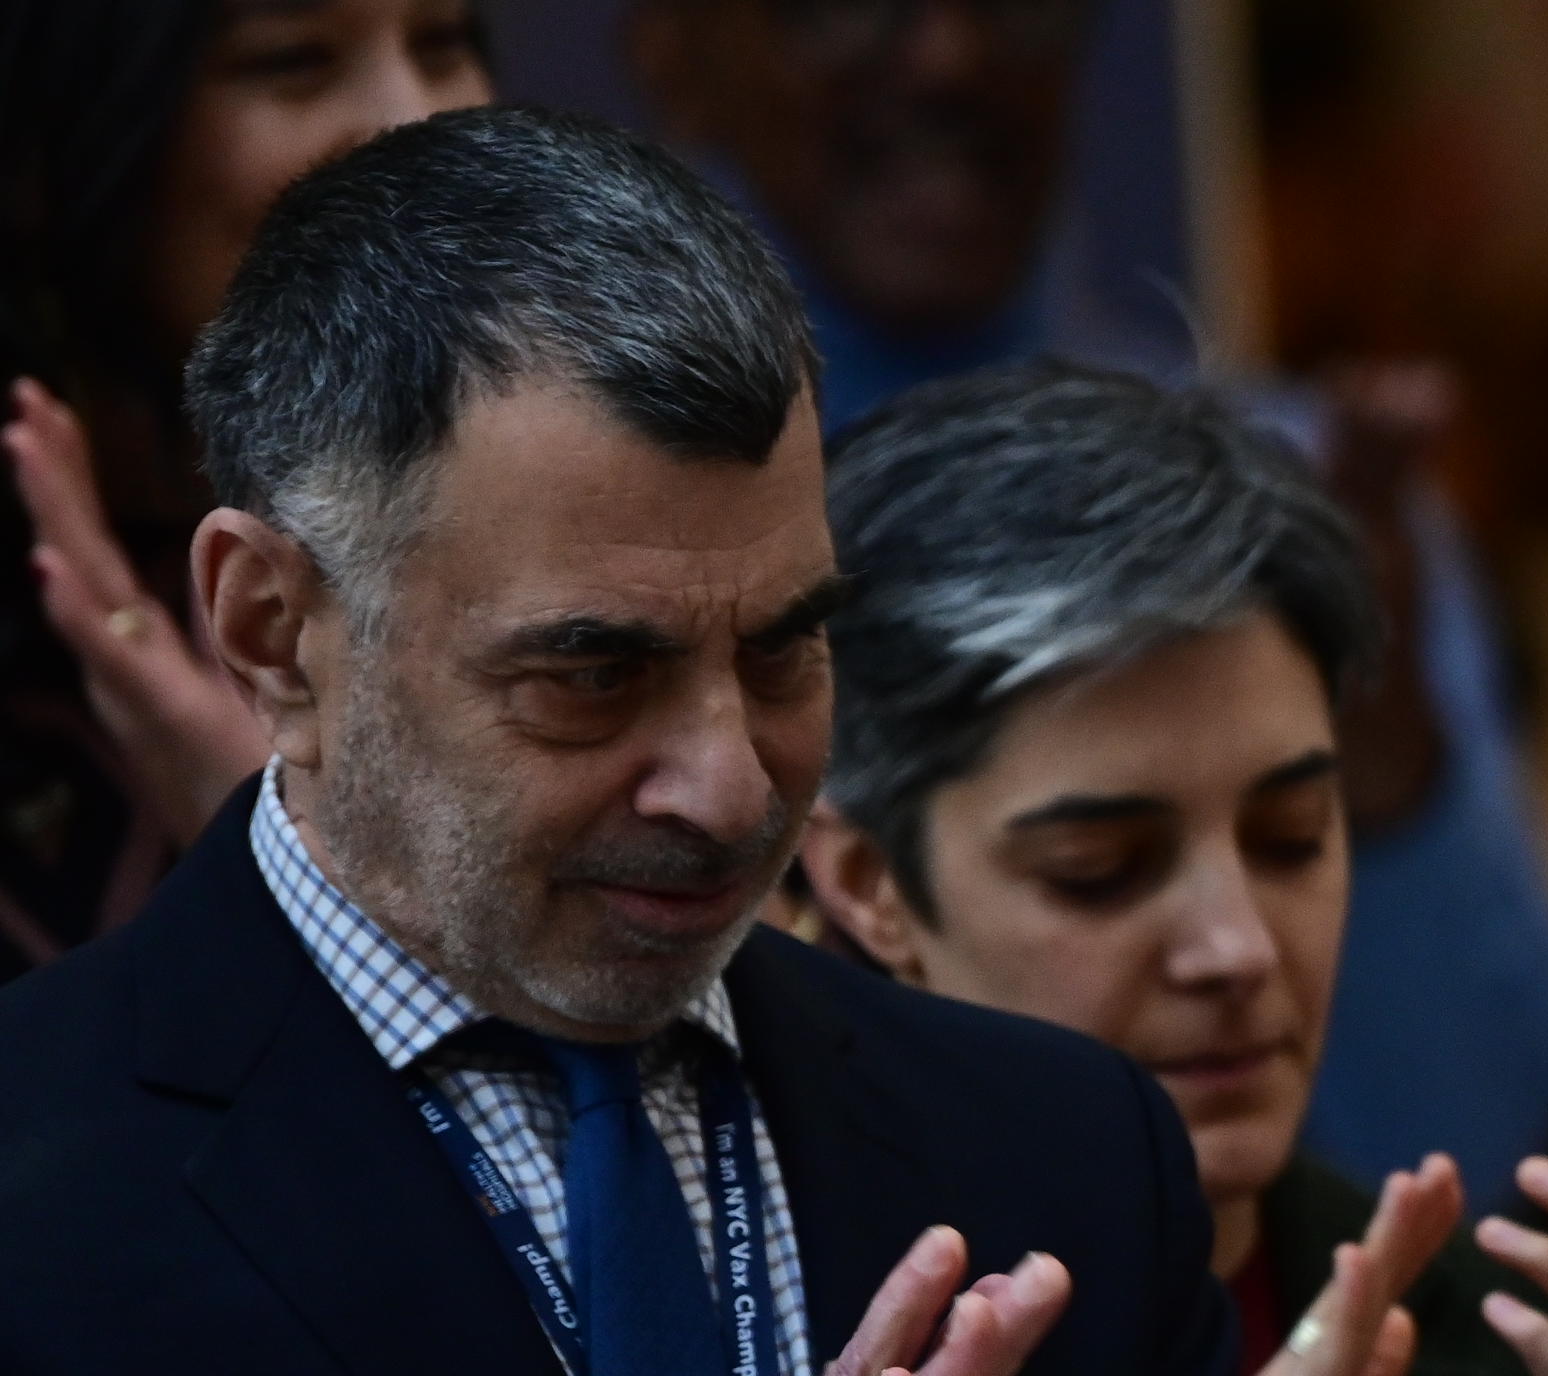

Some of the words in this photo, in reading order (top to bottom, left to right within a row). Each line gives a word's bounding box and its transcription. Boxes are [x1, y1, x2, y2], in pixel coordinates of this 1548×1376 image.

[418, 1100, 452, 1135] I'm
[714, 1120, 738, 1154] I'm
[718, 1155, 739, 1183] an
[722, 1185, 750, 1238] NYC
[727, 1240, 753, 1288] Vax
[516, 1241, 579, 1330] Champ!
